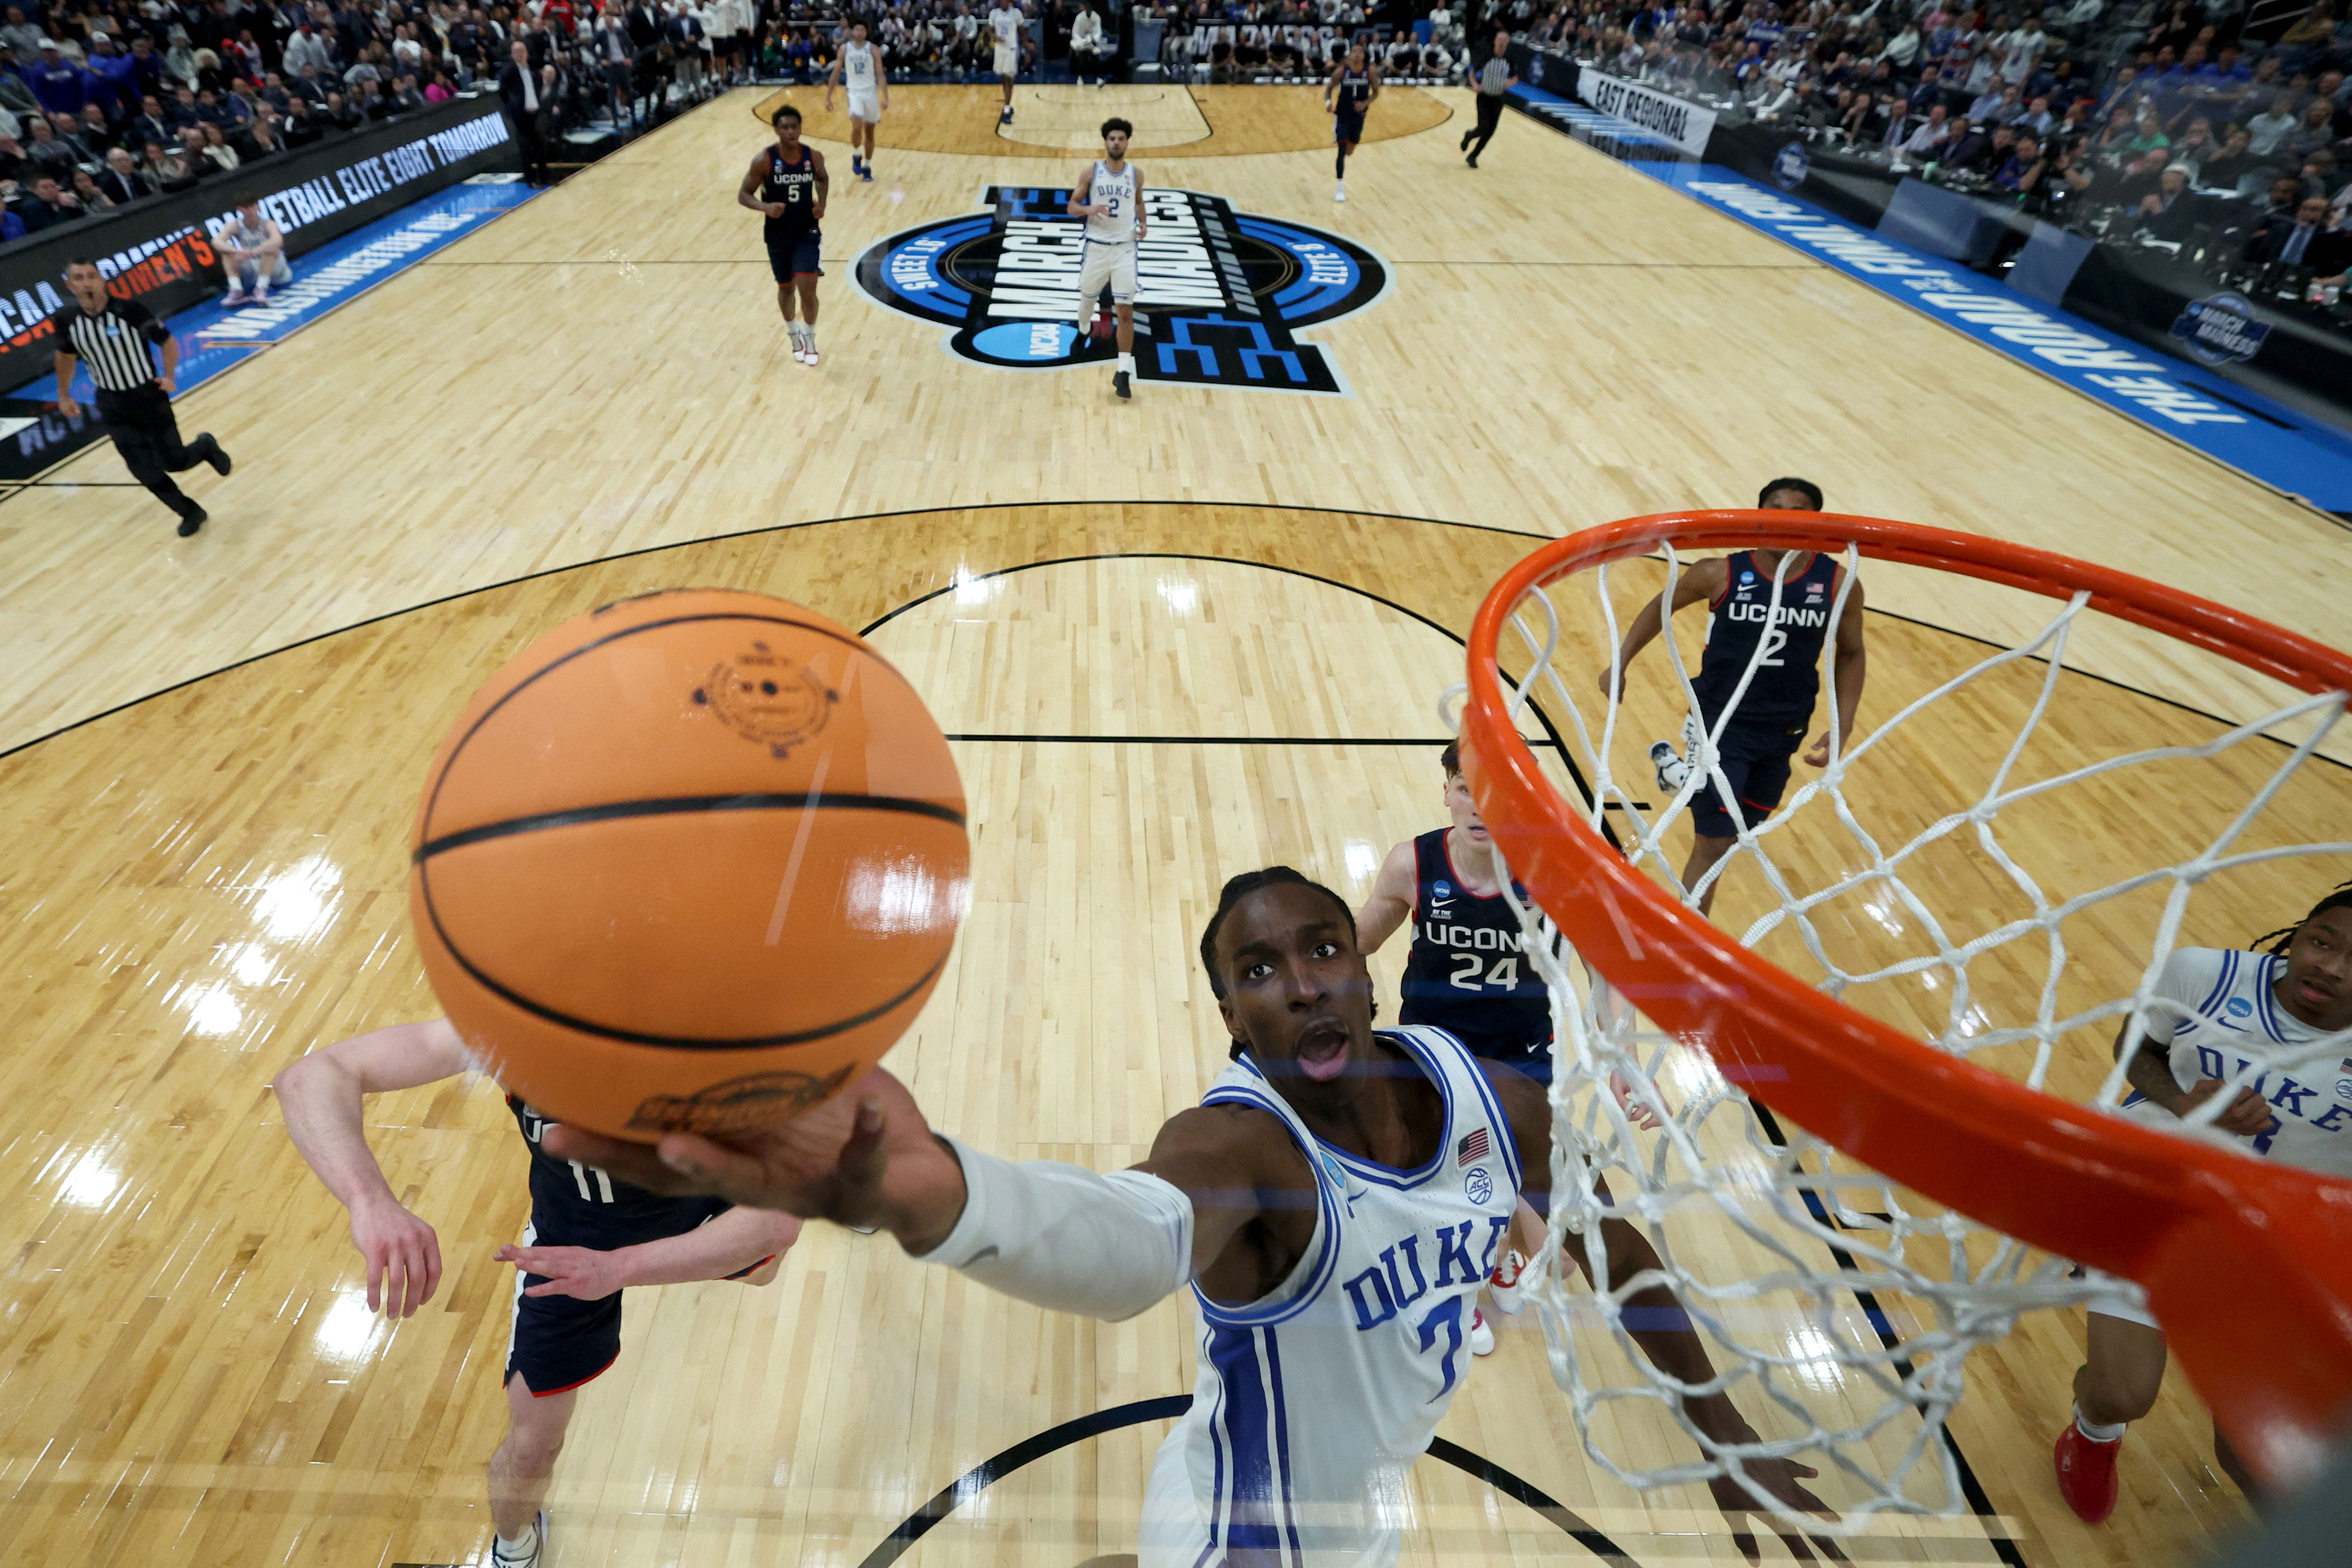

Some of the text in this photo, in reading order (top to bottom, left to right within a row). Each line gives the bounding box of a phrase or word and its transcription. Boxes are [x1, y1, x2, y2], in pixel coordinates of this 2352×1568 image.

[854, 62, 865, 74] 12
[1595, 80, 1625, 116] EAST
[1624, 91, 1689, 141] REGIONAL
[773, 173, 814, 184] UCONN
[788, 184, 800, 202] 5
[1097, 185, 1132, 199] DUKE
[1109, 197, 1119, 218] 2
[0, 111, 509, 353] CAA OMEN'S BAETBALL ELITE EIGHT TOMORROW
[1775, 224, 1952, 278] FINAL
[195, 232, 441, 338] WASHINGTON
[891, 253, 939, 291] SWEET
[987, 220, 1101, 322] MARCH
[1303, 252, 1349, 285] ELITE
[1029, 323, 1060, 357] NCAA
[1919, 292, 2166, 372] ROAD
[2082, 373, 2247, 424] THE
[1728, 602, 1826, 628] UCONN
[1760, 629, 1788, 667] 2
[1426, 922, 1523, 952] UCON
[1451, 952, 1519, 991] 24
[568, 1158, 615, 1203] 11
[1469, 1176, 1490, 1192] ACC
[1342, 1216, 1510, 1331] DUKE
[1417, 1295, 1463, 1405] 7
